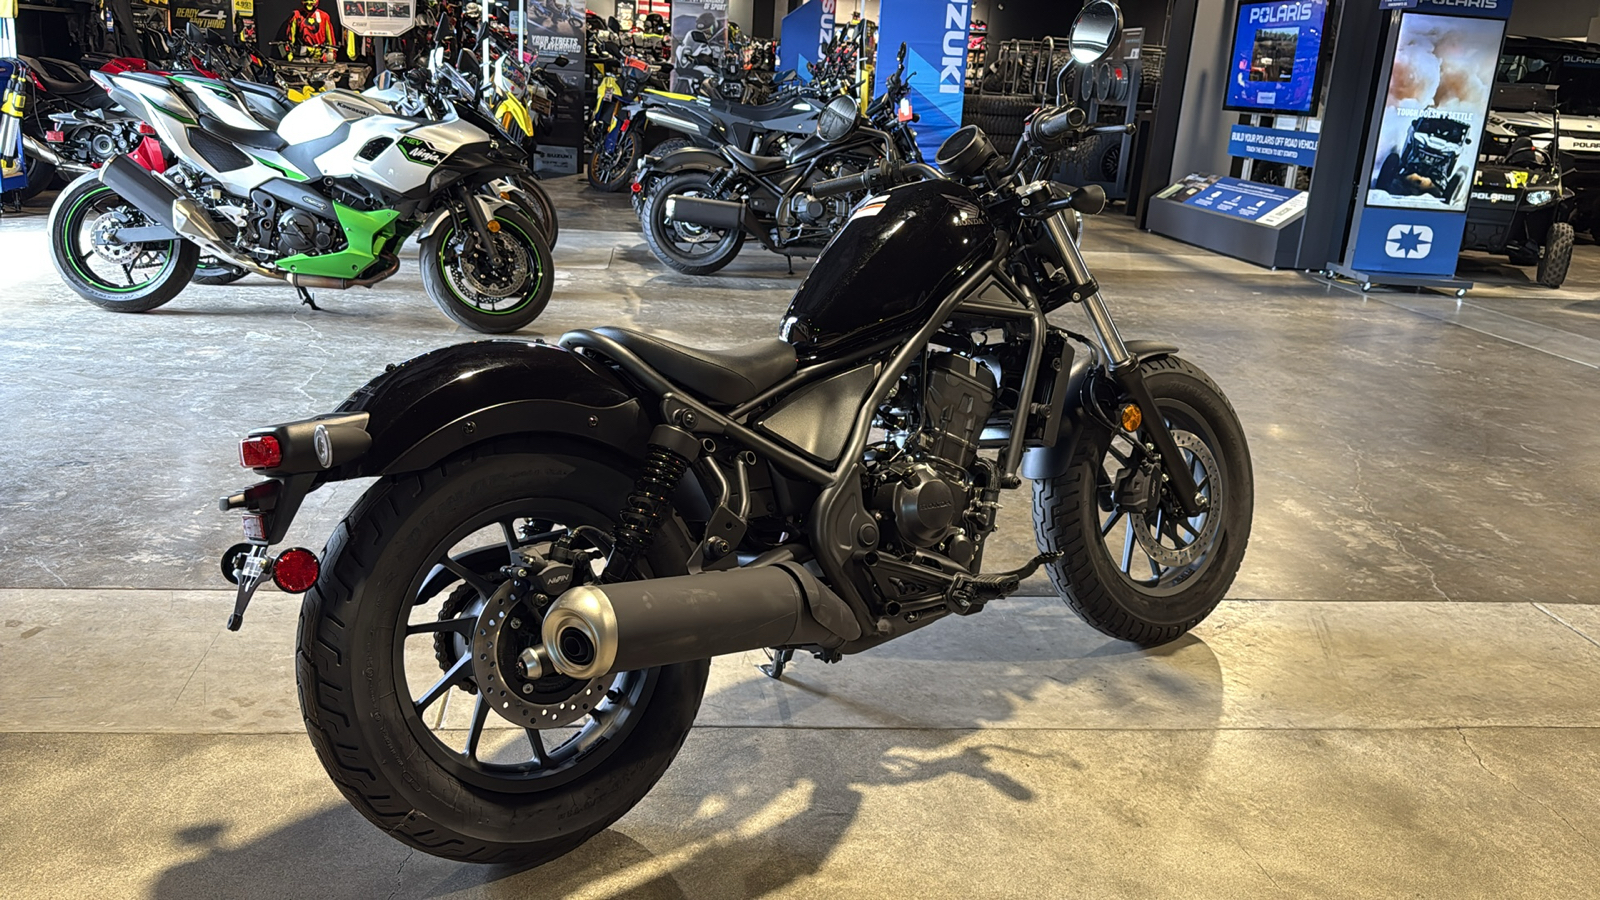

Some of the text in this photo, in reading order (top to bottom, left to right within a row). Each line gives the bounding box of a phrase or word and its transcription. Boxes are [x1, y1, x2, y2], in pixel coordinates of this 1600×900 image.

[1420, 0, 1498, 9] OLARIS
[176, 8, 227, 20] READY 4
[1249, 3, 1312, 23] POLARIS
[189, 18, 226, 29] ANYTHING
[818, 0, 835, 63] SUZU
[532, 35, 579, 46] YOUR STREETS
[540, 43, 582, 53] PLAYGROUND
[939, 0, 967, 94] ZUKI
[337, 102, 370, 117] Kawasaki
[1397, 108, 1474, 121] TOUGH DOESN'T SETTLE
[403, 137, 423, 146] HEV
[1231, 131, 1244, 141] BUILD
[1245, 133, 1257, 143] YOUR
[1256, 134, 1275, 145] POLARIS
[1275, 137, 1284, 146] OFF
[1284, 138, 1298, 148] ROAD
[409, 147, 440, 162] Ninja
[1470, 192, 1516, 202] POLARIS
[955, 218, 984, 226] HONDA
